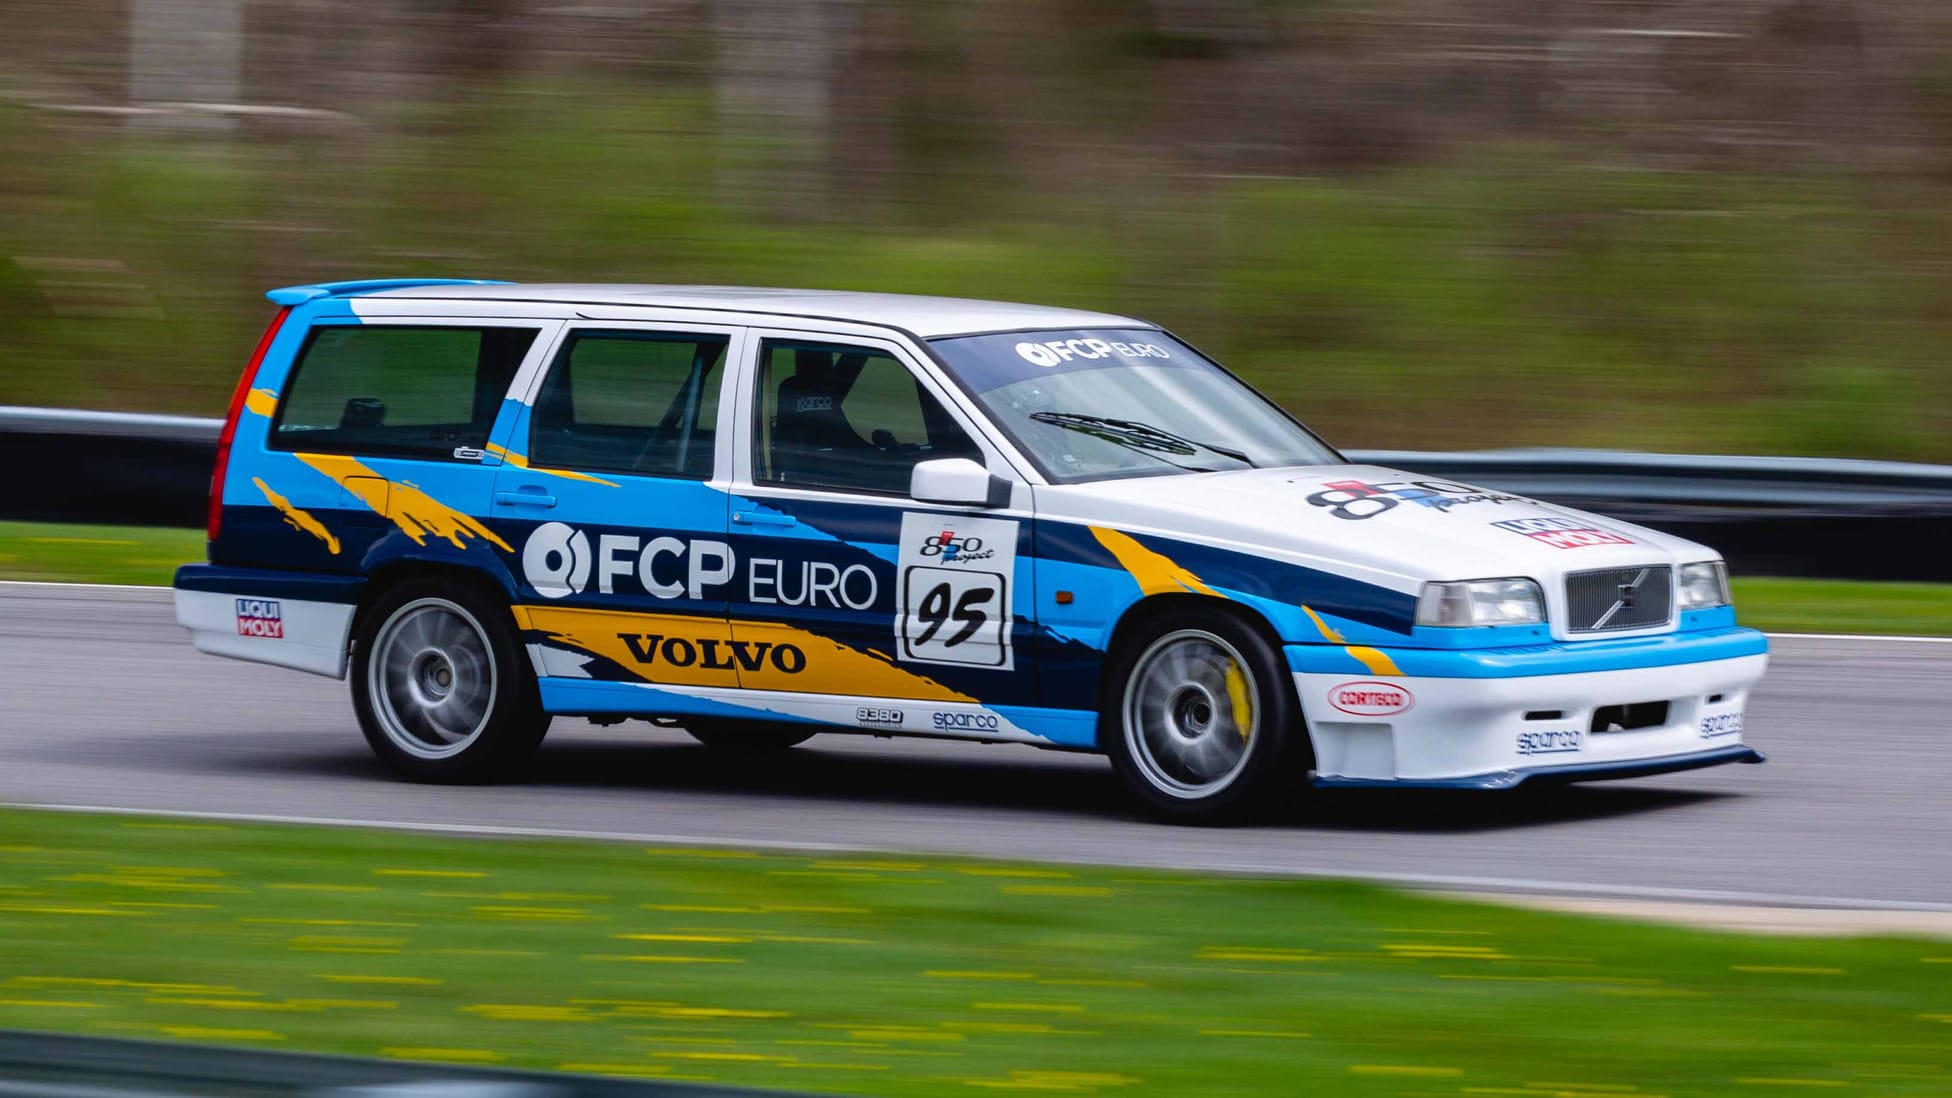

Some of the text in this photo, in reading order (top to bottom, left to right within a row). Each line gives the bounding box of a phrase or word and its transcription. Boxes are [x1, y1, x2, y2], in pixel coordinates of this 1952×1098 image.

[1046, 338, 1170, 362] FCP EURO
[919, 535, 983, 557] 850
[940, 549, 995, 565] project
[599, 534, 878, 610] FCP EURO
[237, 600, 279, 618] LIQUI
[914, 582, 995, 648] 95
[239, 619, 282, 637] MOLY
[616, 633, 807, 674] VOLVO
[1339, 691, 1403, 706] CORTECO
[932, 712, 999, 732] sparco
[1516, 731, 1580, 756] sparco
